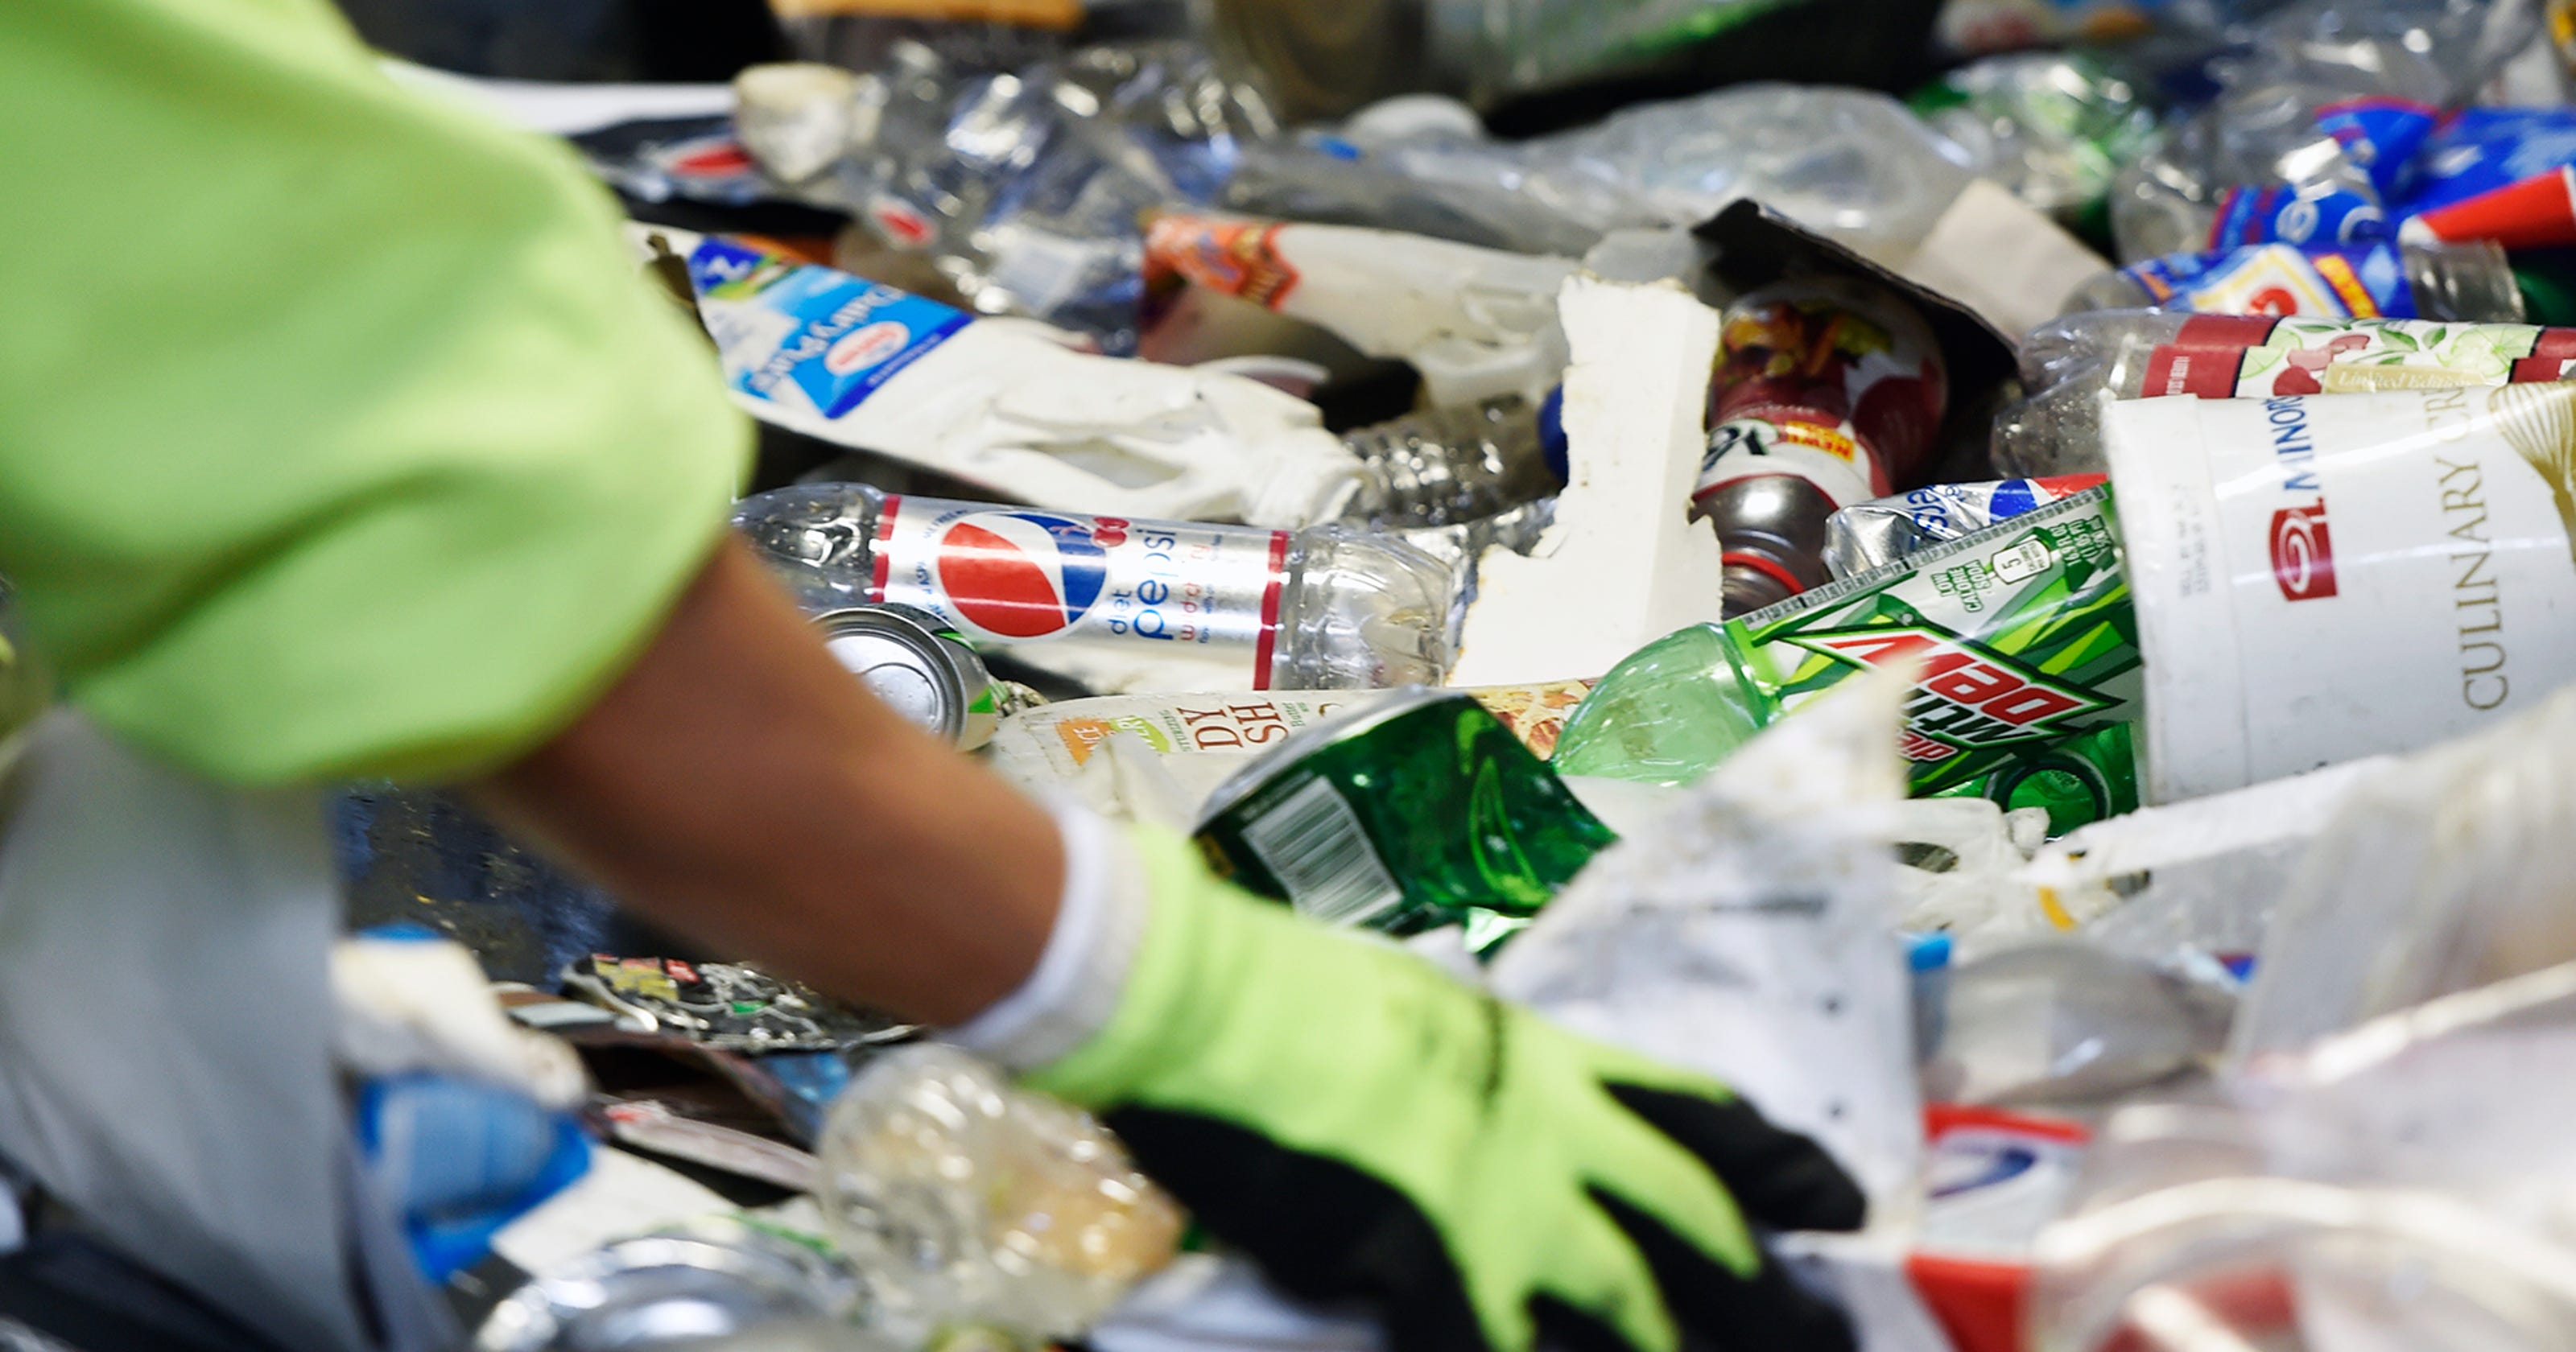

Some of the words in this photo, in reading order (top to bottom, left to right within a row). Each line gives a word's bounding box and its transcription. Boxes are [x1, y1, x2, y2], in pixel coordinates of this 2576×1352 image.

[2337, 370, 2406, 390] Limited
[1966, 560, 1993, 591] SODA
[2001, 558, 2021, 571] 5
[2058, 544, 2079, 567] 16.9
[1133, 528, 1179, 641] pepsi
[1931, 573, 1955, 597] LOW
[1946, 565, 1984, 612] CALORIE
[2434, 455, 2509, 711] CULINARY
[1107, 588, 1133, 635] diet
[1175, 706, 1244, 751] DY
[1228, 701, 1288, 744] SH
